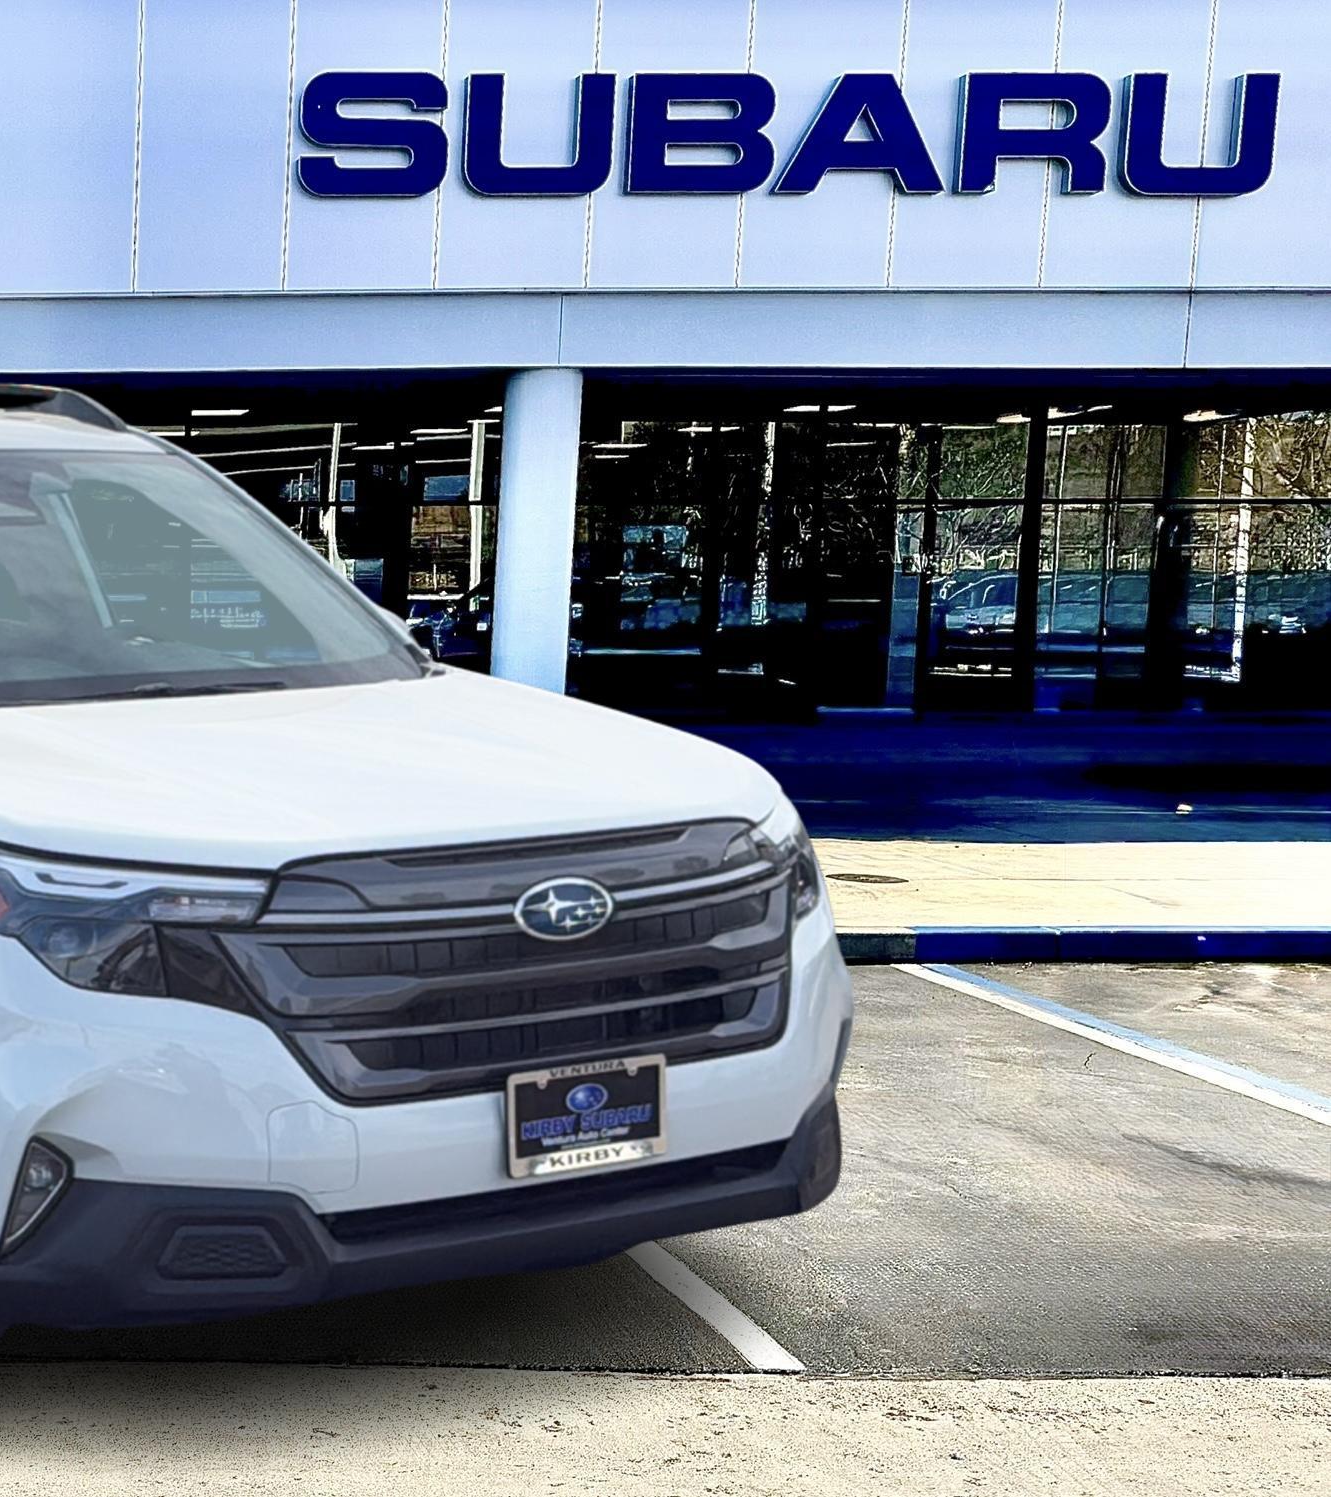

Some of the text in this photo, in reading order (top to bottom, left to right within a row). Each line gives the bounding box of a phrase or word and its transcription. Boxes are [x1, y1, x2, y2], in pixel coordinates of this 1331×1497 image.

[298, 72, 1280, 197] SUBARU
[550, 1060, 627, 1077] VENTURA
[521, 1104, 652, 1140] KIRBY SUBARU
[550, 1147, 624, 1167] KIRBY
